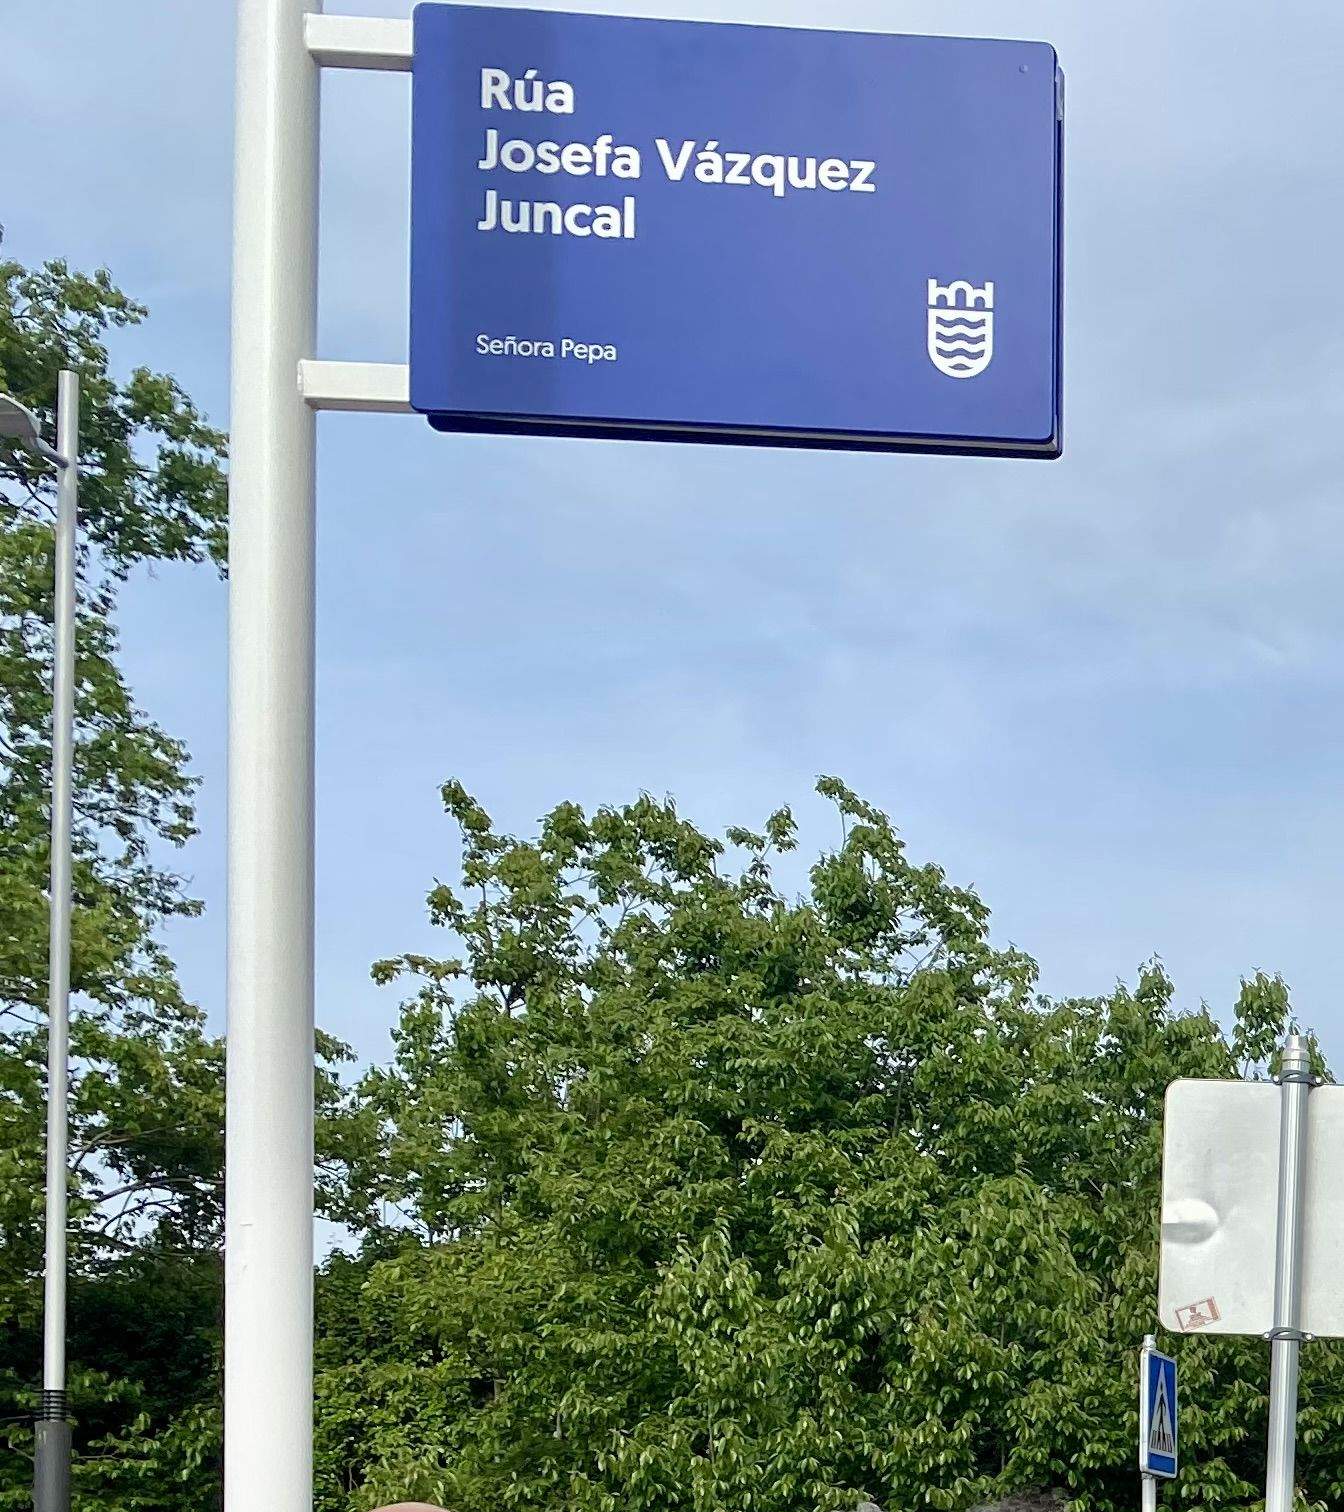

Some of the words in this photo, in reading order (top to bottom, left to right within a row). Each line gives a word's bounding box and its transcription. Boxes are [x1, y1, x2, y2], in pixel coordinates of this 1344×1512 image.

[481, 68, 574, 114] Rúa
[478, 129, 641, 179] Josefa
[655, 138, 876, 197] Vázquez
[478, 190, 635, 238] Juncal
[476, 333, 554, 357] Señora
[561, 338, 617, 364] Pepa
